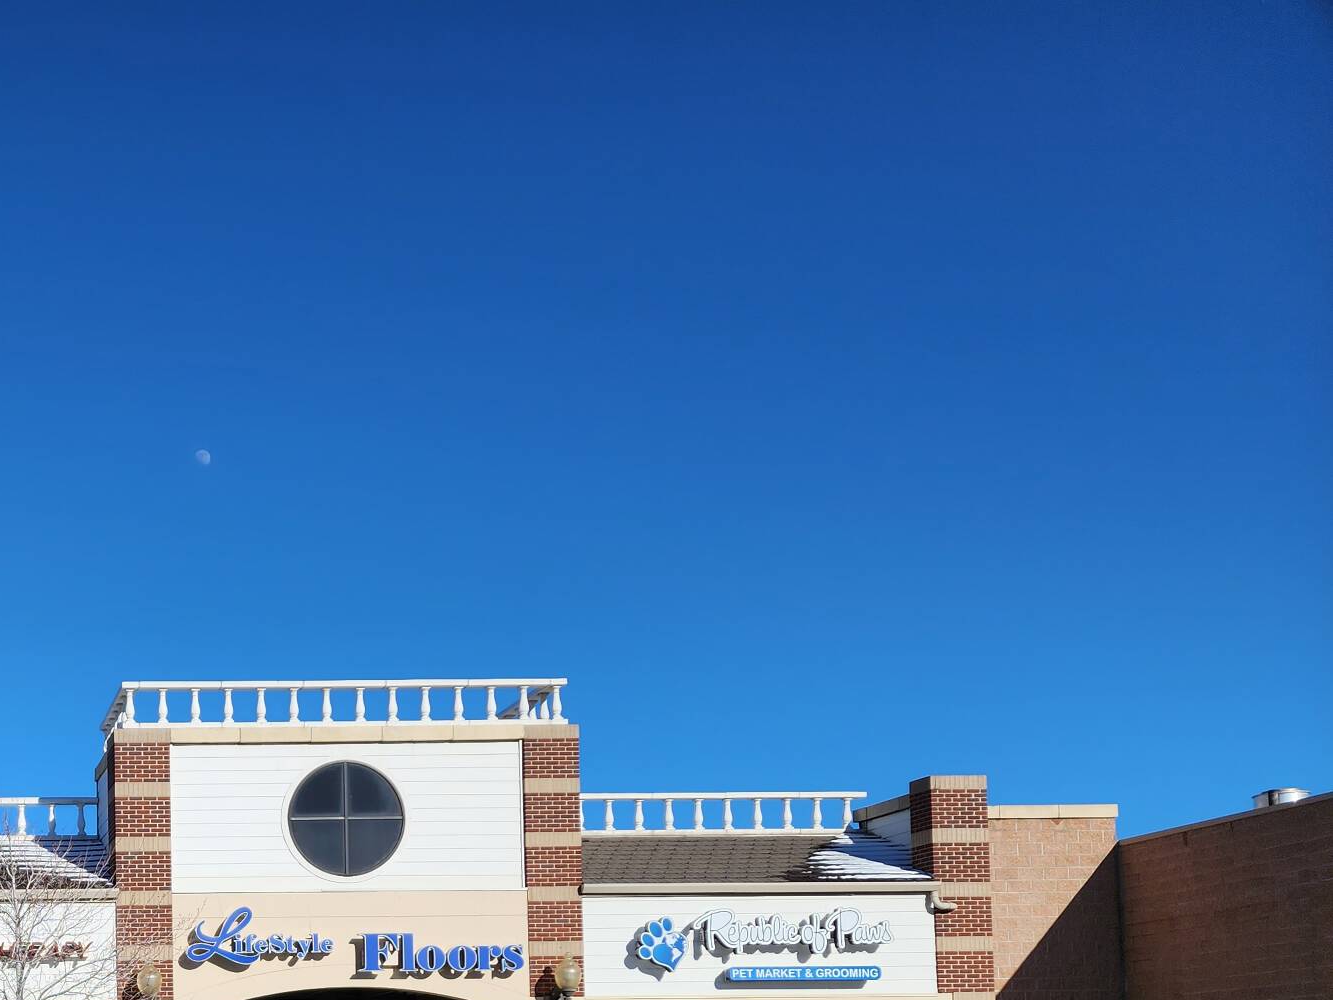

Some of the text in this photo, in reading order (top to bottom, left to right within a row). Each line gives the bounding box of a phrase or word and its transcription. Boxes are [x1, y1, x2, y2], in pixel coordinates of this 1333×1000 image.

[186, 906, 525, 973] LifeStyle Floors
[694, 907, 895, 954] Republic of Paws
[732, 968, 879, 978] PET MARKET & GROOMING
